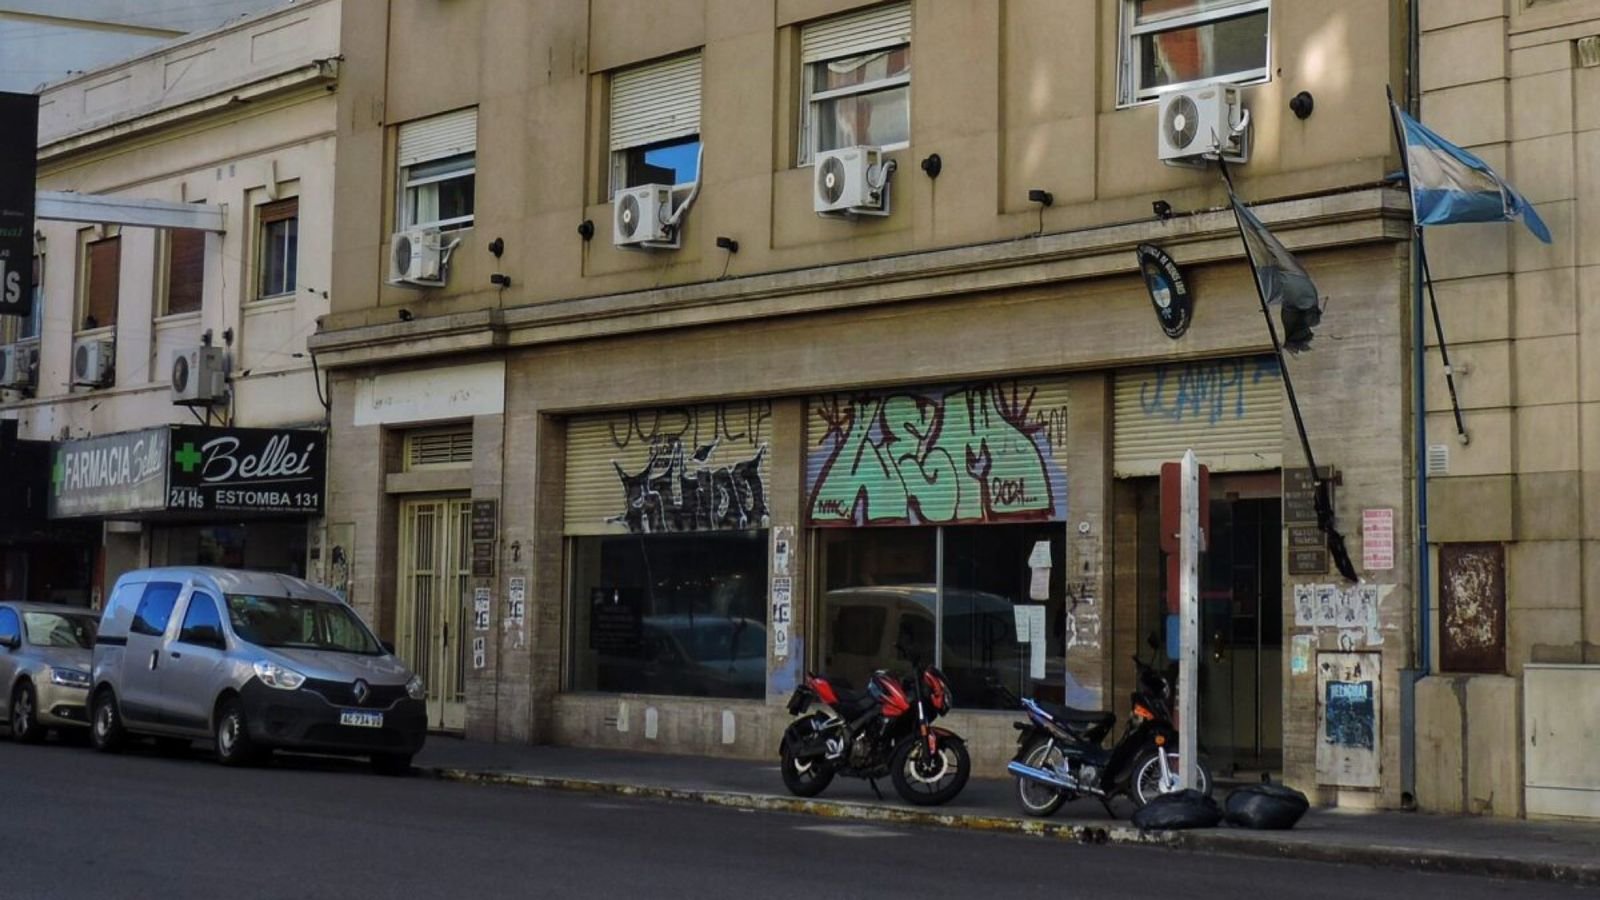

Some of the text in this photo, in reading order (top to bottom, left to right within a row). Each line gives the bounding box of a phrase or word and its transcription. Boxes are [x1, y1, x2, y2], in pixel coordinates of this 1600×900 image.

[64, 446, 131, 490] FARMACIA
[201, 434, 315, 483] Bellei
[170, 490, 185, 507] 24
[188, 490, 205, 508] Hs
[215, 490, 319, 507] ESTOMBA 131
